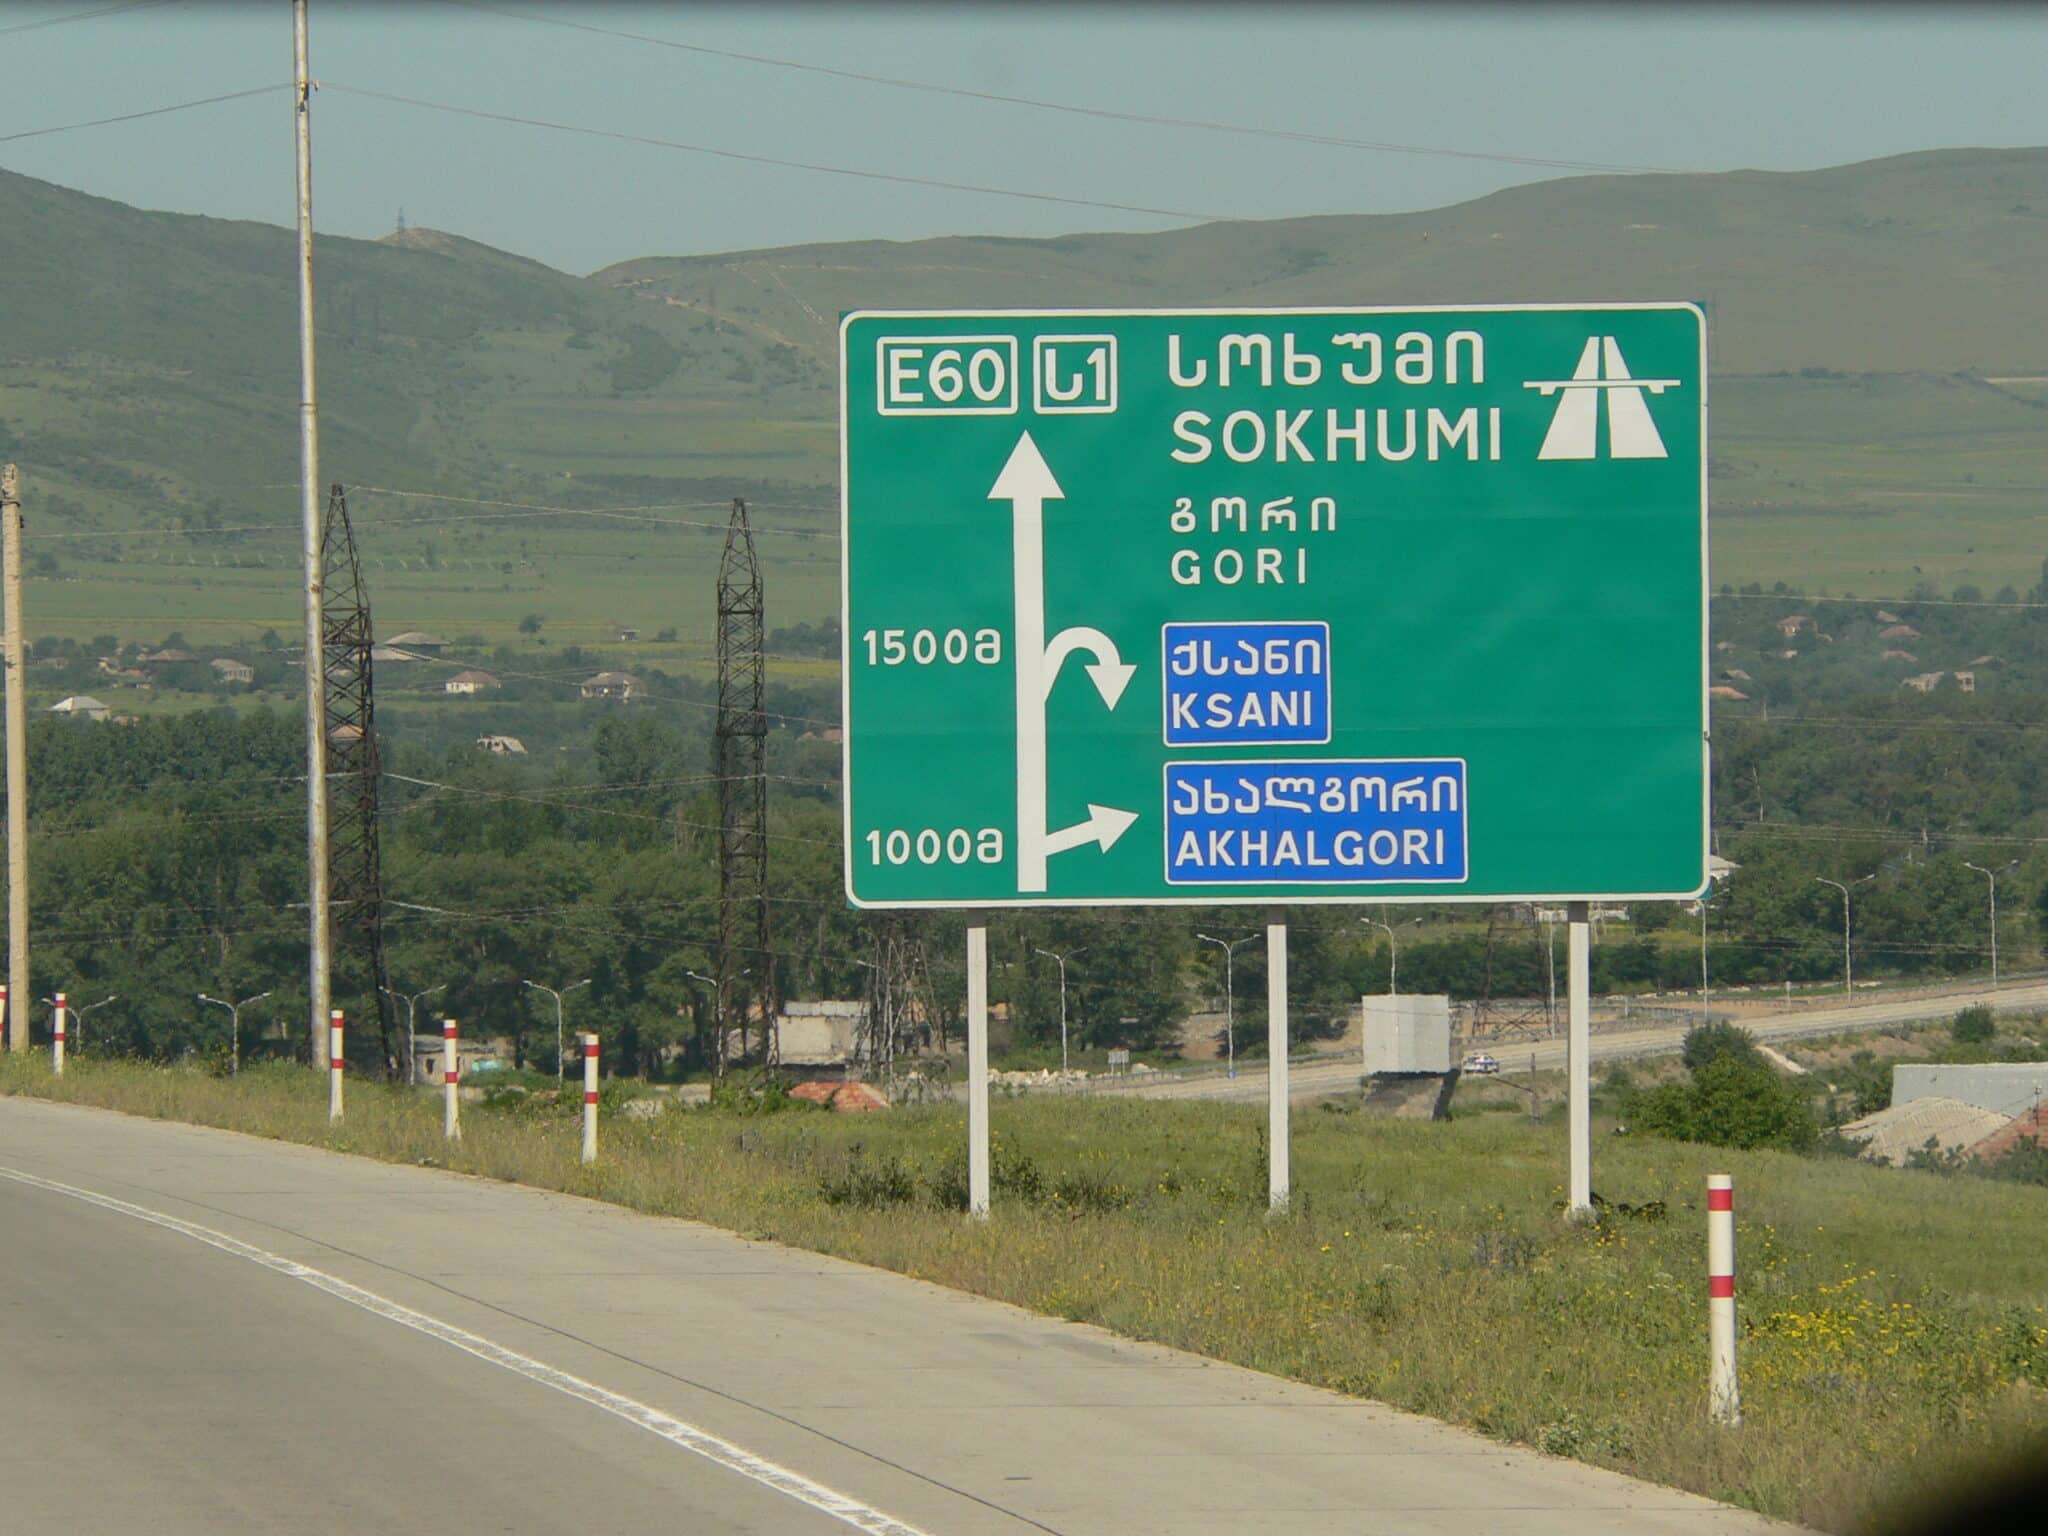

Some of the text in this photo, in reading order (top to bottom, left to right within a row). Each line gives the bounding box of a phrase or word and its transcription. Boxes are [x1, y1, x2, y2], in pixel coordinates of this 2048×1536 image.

[890, 349, 1004, 402] E60
[1046, 348, 1106, 400] ს1
[1169, 331, 1483, 387] სოხუმი
[1171, 408, 1500, 463] SOKHUMI
[1171, 497, 1335, 532] გორი
[1172, 549, 1305, 584] GORI
[864, 629, 1000, 664] 1500მ
[1172, 640, 1320, 675] ქსანი
[1173, 691, 1311, 728] KSANI
[1174, 776, 1457, 814] ახალგორი
[867, 829, 1002, 864] 1000მ
[1176, 829, 1443, 866] AKHALGORI
